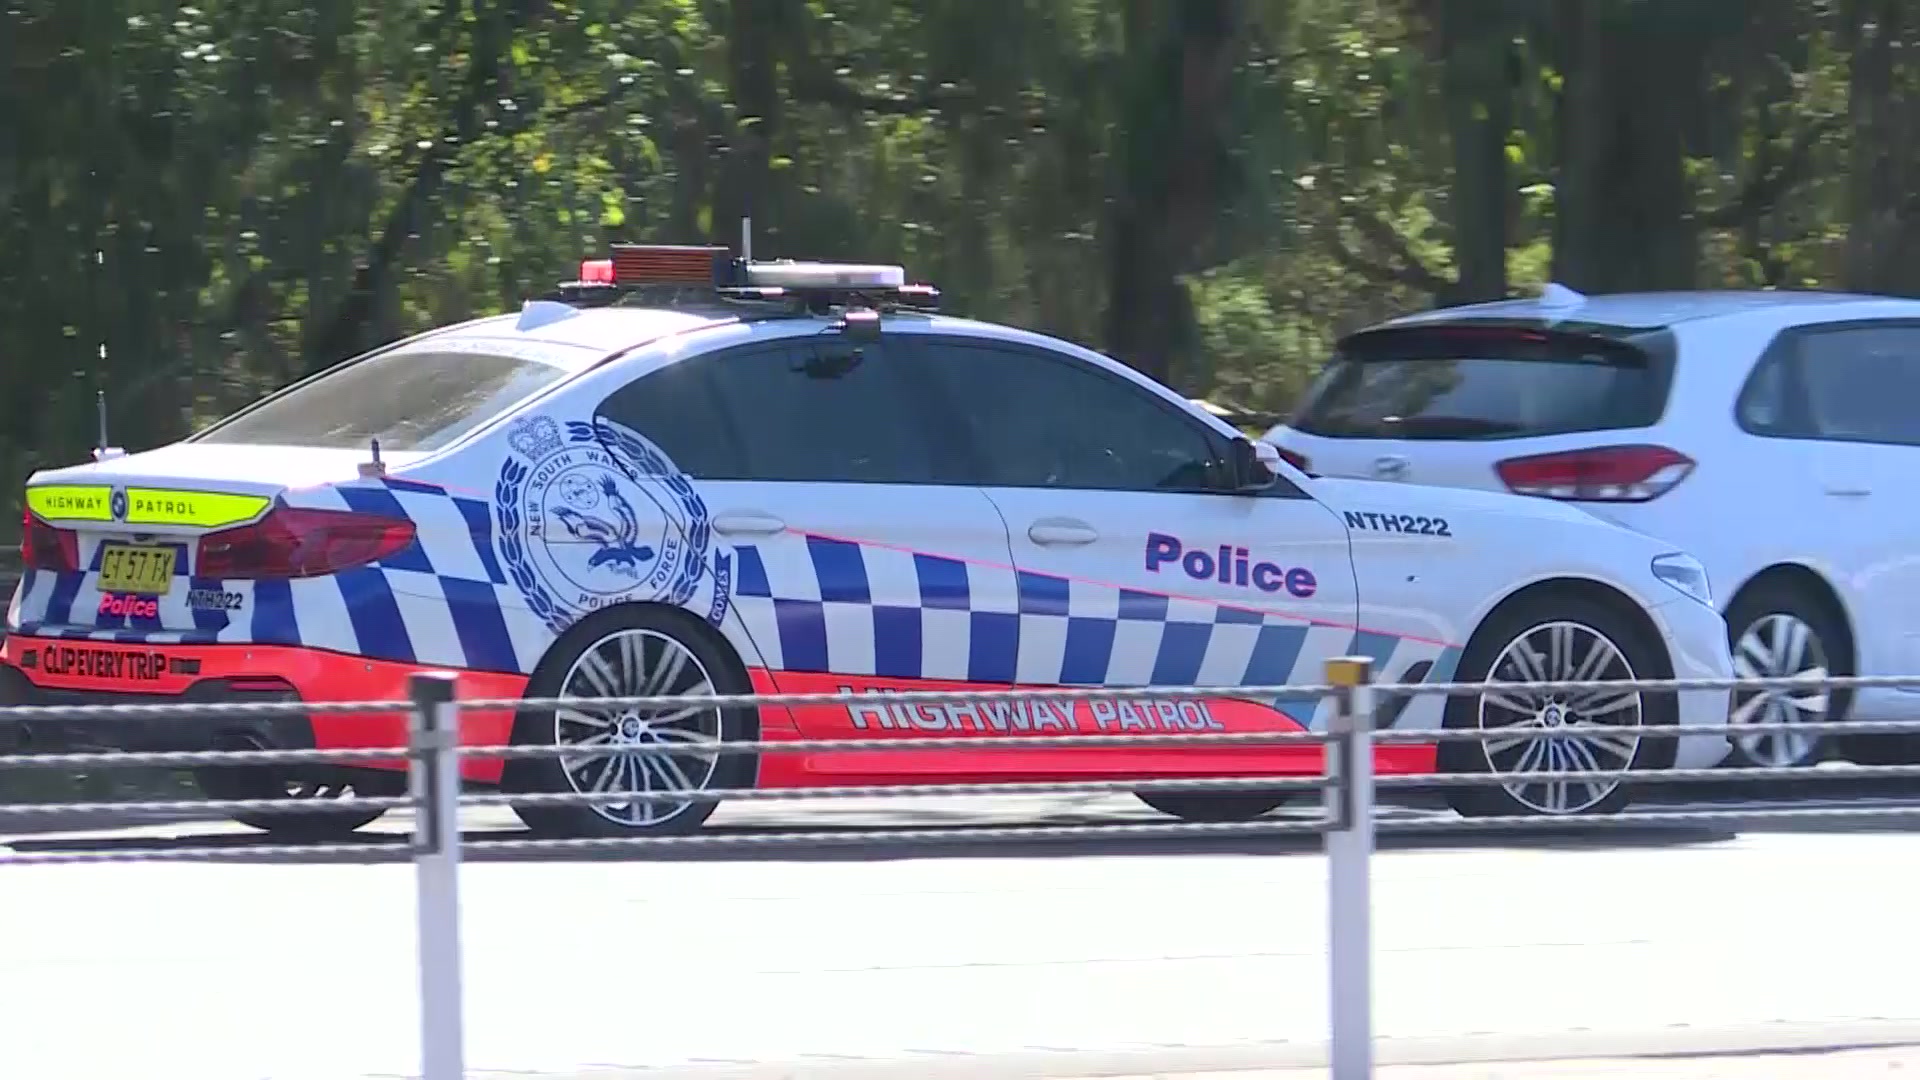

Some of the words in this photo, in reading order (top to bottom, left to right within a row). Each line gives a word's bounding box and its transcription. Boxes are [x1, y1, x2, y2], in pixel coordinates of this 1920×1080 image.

[533, 455, 572, 490] SOUTH
[46, 496, 103, 509] HIGHWAY
[136, 499, 197, 515] PATROL
[529, 502, 541, 536] NEW
[1343, 510, 1452, 537] NTH222
[650, 538, 677, 590] FORCE
[1145, 532, 1317, 598] Police
[99, 592, 157, 616] Police
[184, 590, 243, 609] NTH222
[43, 645, 75, 674] CLIP
[77, 649, 125, 677] EVERY
[127, 651, 166, 679] TRIP
[838, 685, 1076, 732] HIGHWAY
[1088, 697, 1224, 732] PATROL
